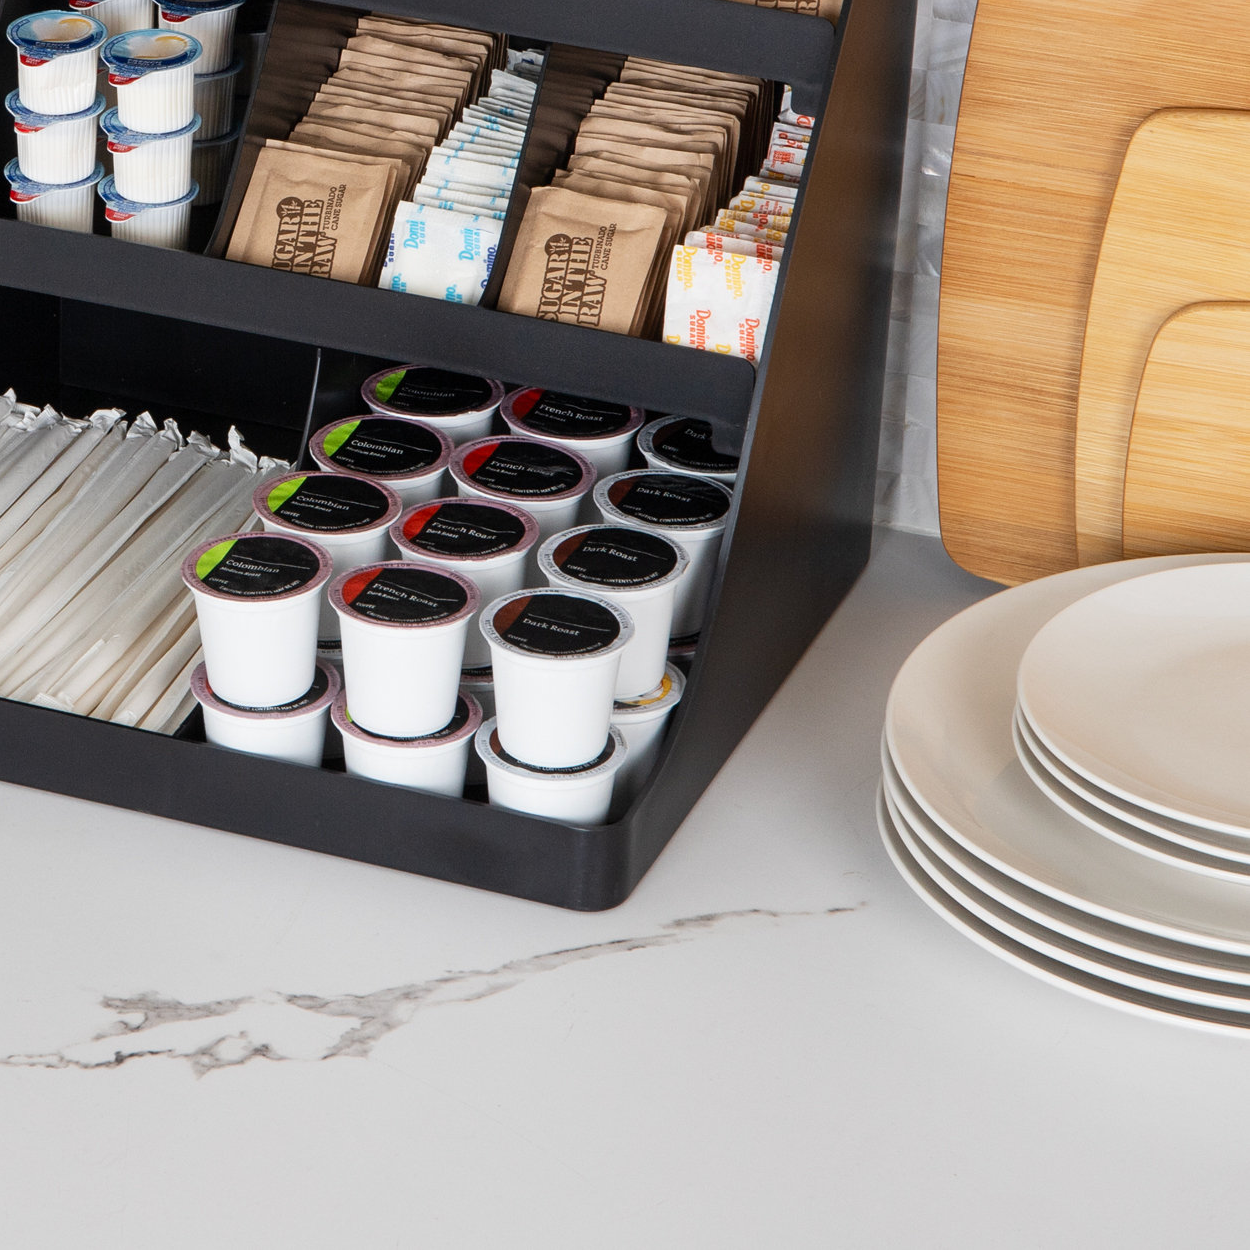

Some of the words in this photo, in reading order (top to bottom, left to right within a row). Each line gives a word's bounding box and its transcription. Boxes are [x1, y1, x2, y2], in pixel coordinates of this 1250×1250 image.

[335, 184, 347, 208] SUGAR
[323, 187, 337, 230] TURBINADO
[331, 209, 341, 231] CANE
[273, 216, 301, 271] UGAR
[605, 223, 617, 247] SUGAR
[591, 226, 607, 269] TURBINADO
[601, 247, 611, 271] CANE
[559, 290, 582, 314] IN
[578, 277, 607, 326] RAW
[738, 323, 746, 355] SUGAR
[745, 318, 760, 361] Domino
[539, 404, 574, 418] French
[575, 413, 604, 422] Roast
[684, 428, 706, 440] Dark
[351, 439, 404, 455] Colombian
[490, 460, 525, 471] French
[296, 495, 350, 511] Colombian
[636, 487, 661, 496] Dark
[663, 491, 692, 503] Roast
[432, 521, 467, 535] French
[468, 529, 497, 540] Roast
[225, 559, 280, 574] Colombian
[608, 549, 638, 562] Roast
[372, 583, 408, 599] French
[408, 595, 439, 608] Roast
[522, 617, 550, 630] Dark
[550, 624, 581, 637] Roast
